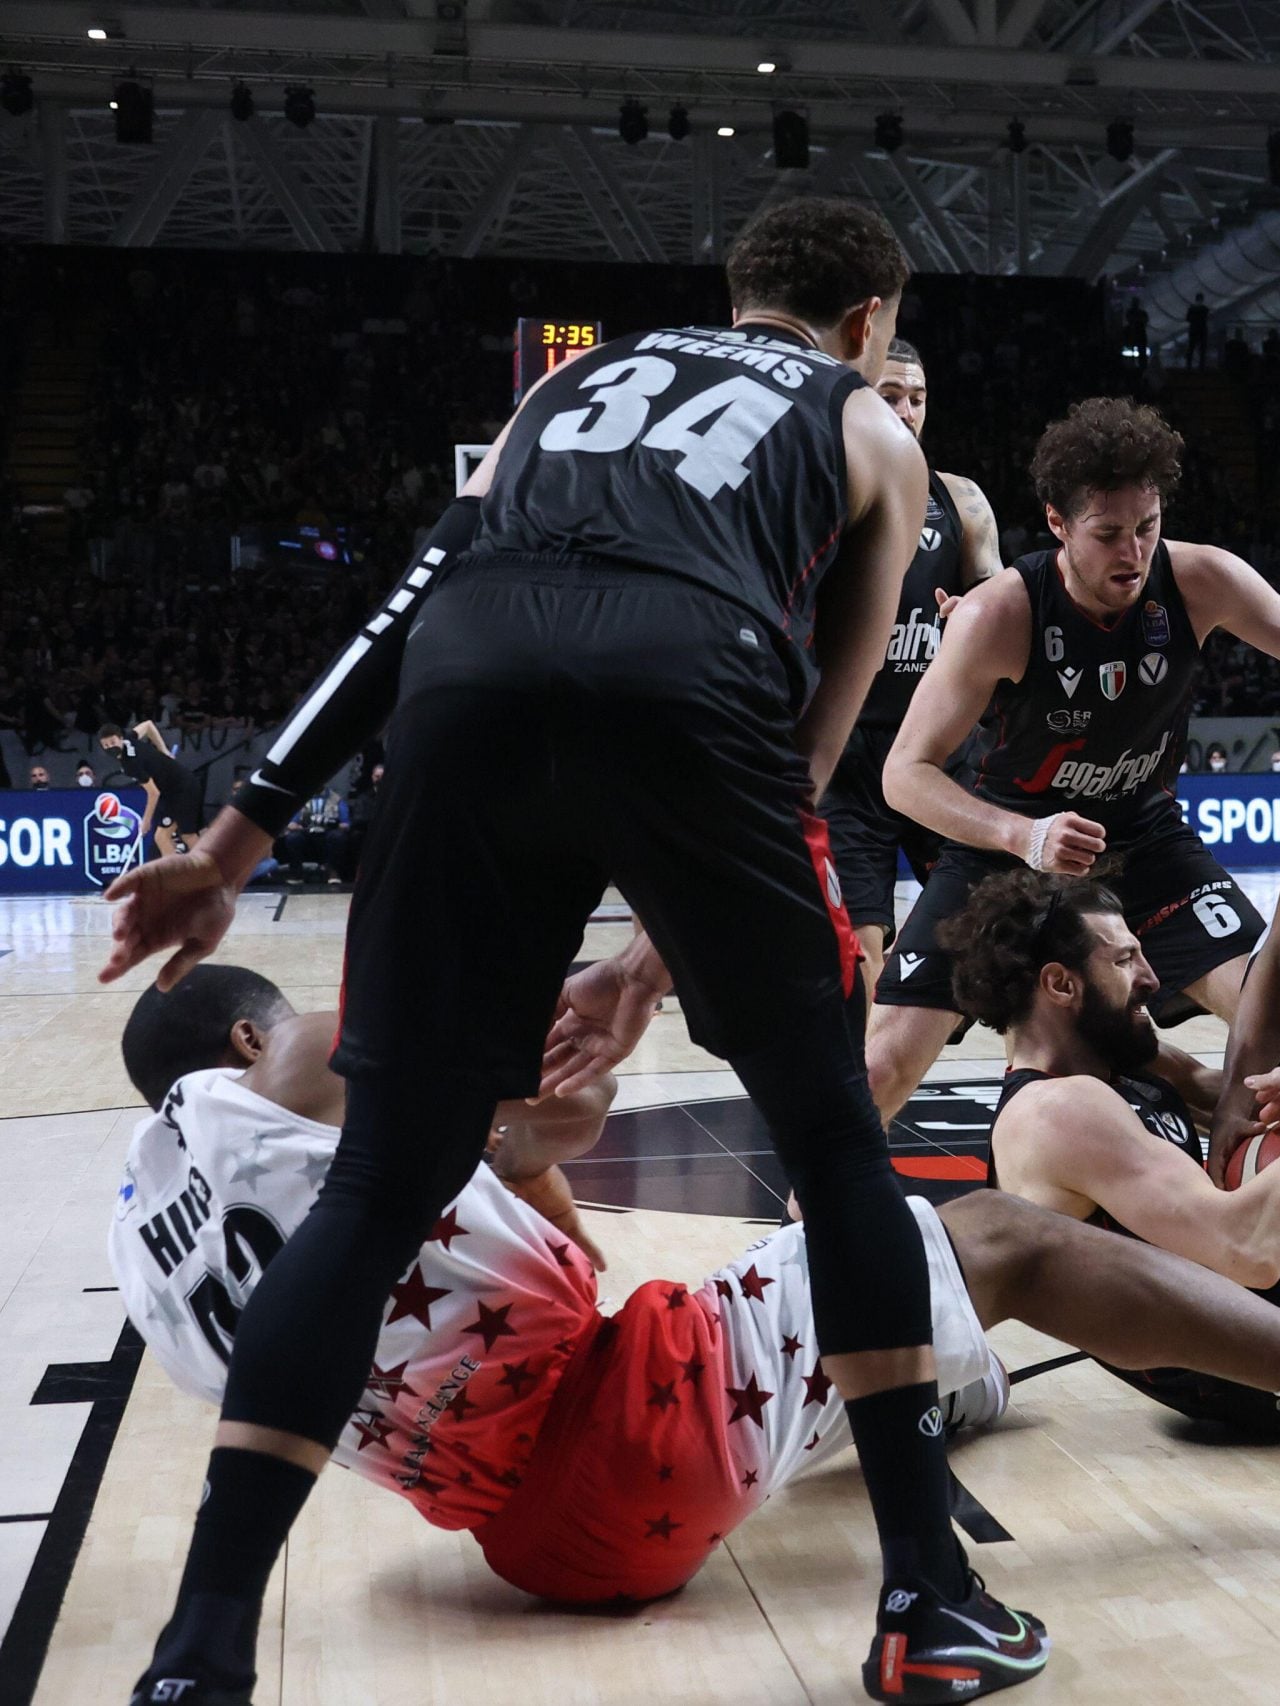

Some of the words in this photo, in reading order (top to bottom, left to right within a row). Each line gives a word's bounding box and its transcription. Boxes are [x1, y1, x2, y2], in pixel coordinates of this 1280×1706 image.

[542, 324, 594, 346] 3:35
[634, 333, 813, 389] WEEMS
[539, 355, 793, 500] 34
[1044, 625, 1065, 662] 6
[894, 662, 930, 673] ZANE
[1189, 880, 1232, 900] CARS
[1192, 893, 1241, 938] 6
